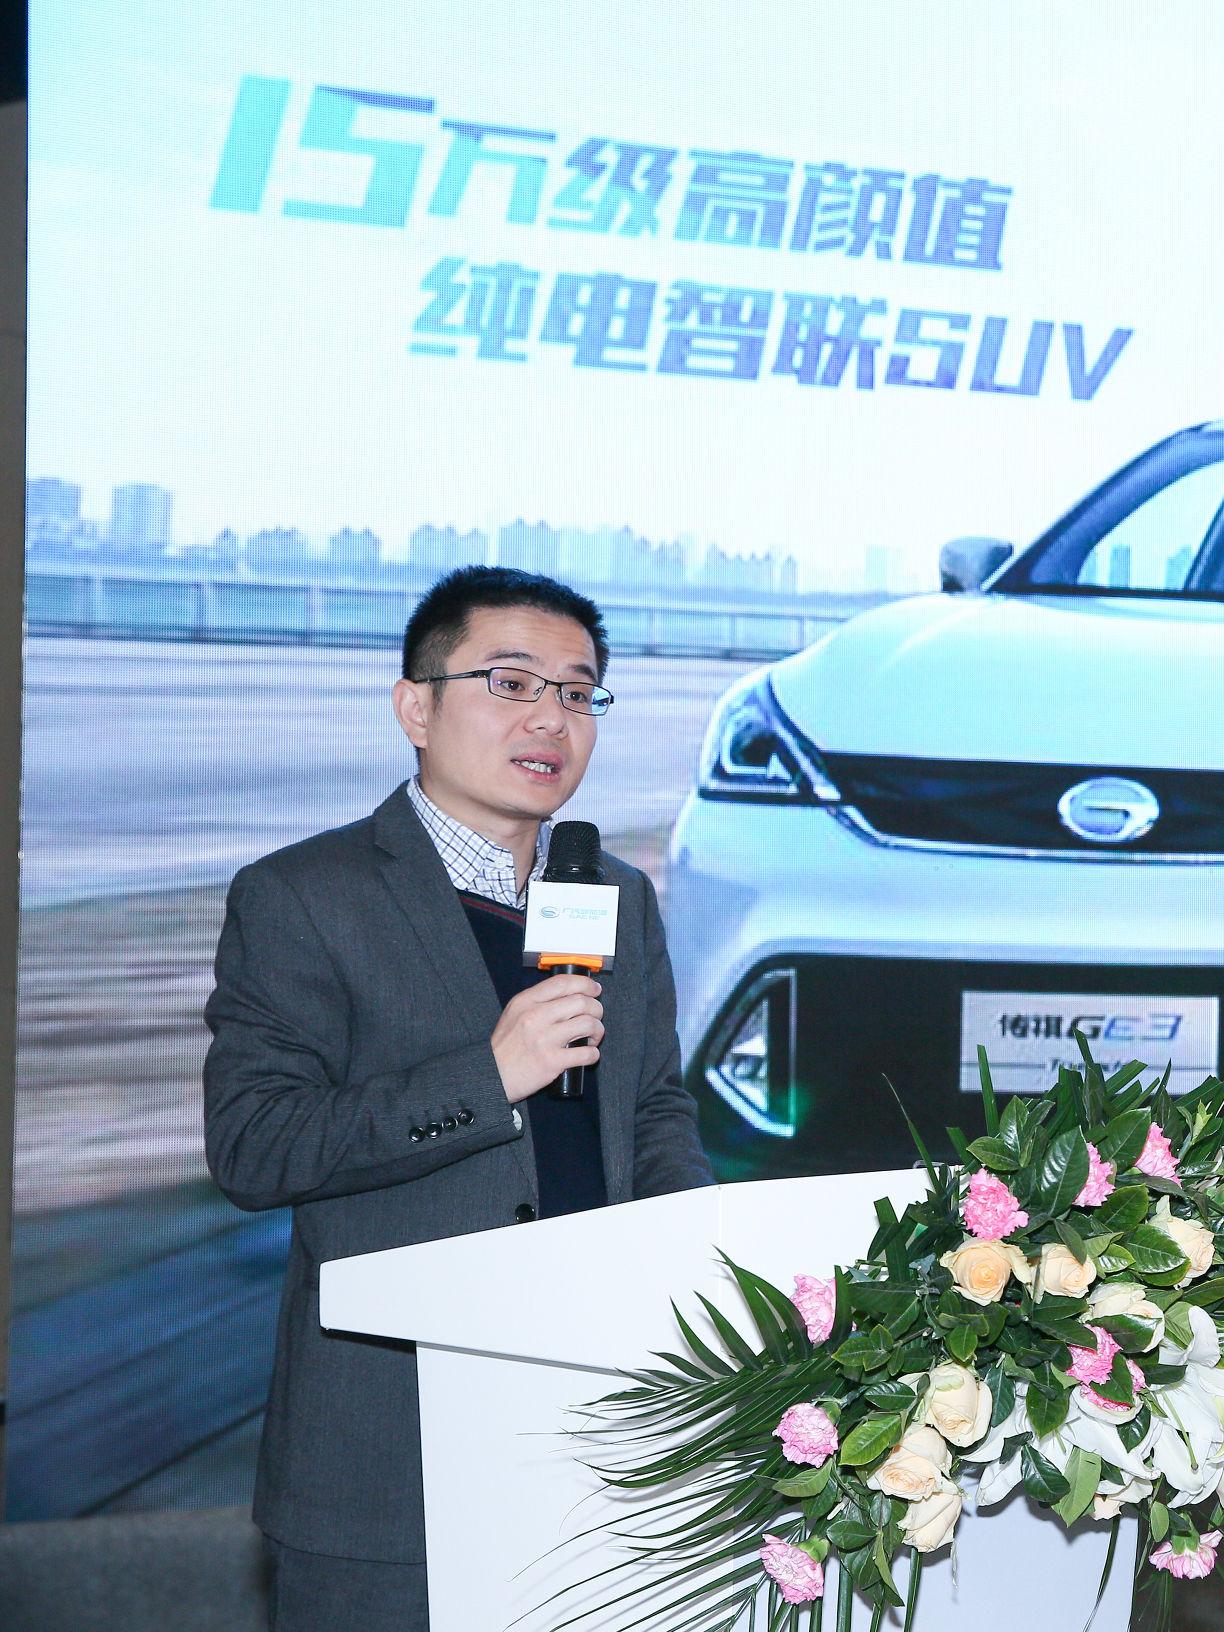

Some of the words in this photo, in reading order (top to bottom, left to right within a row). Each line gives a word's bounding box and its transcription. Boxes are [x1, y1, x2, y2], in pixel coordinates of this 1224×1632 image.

[207, 73, 1014, 272] 15万级高颜值
[408, 255, 1134, 401] 纯电智联SUV
